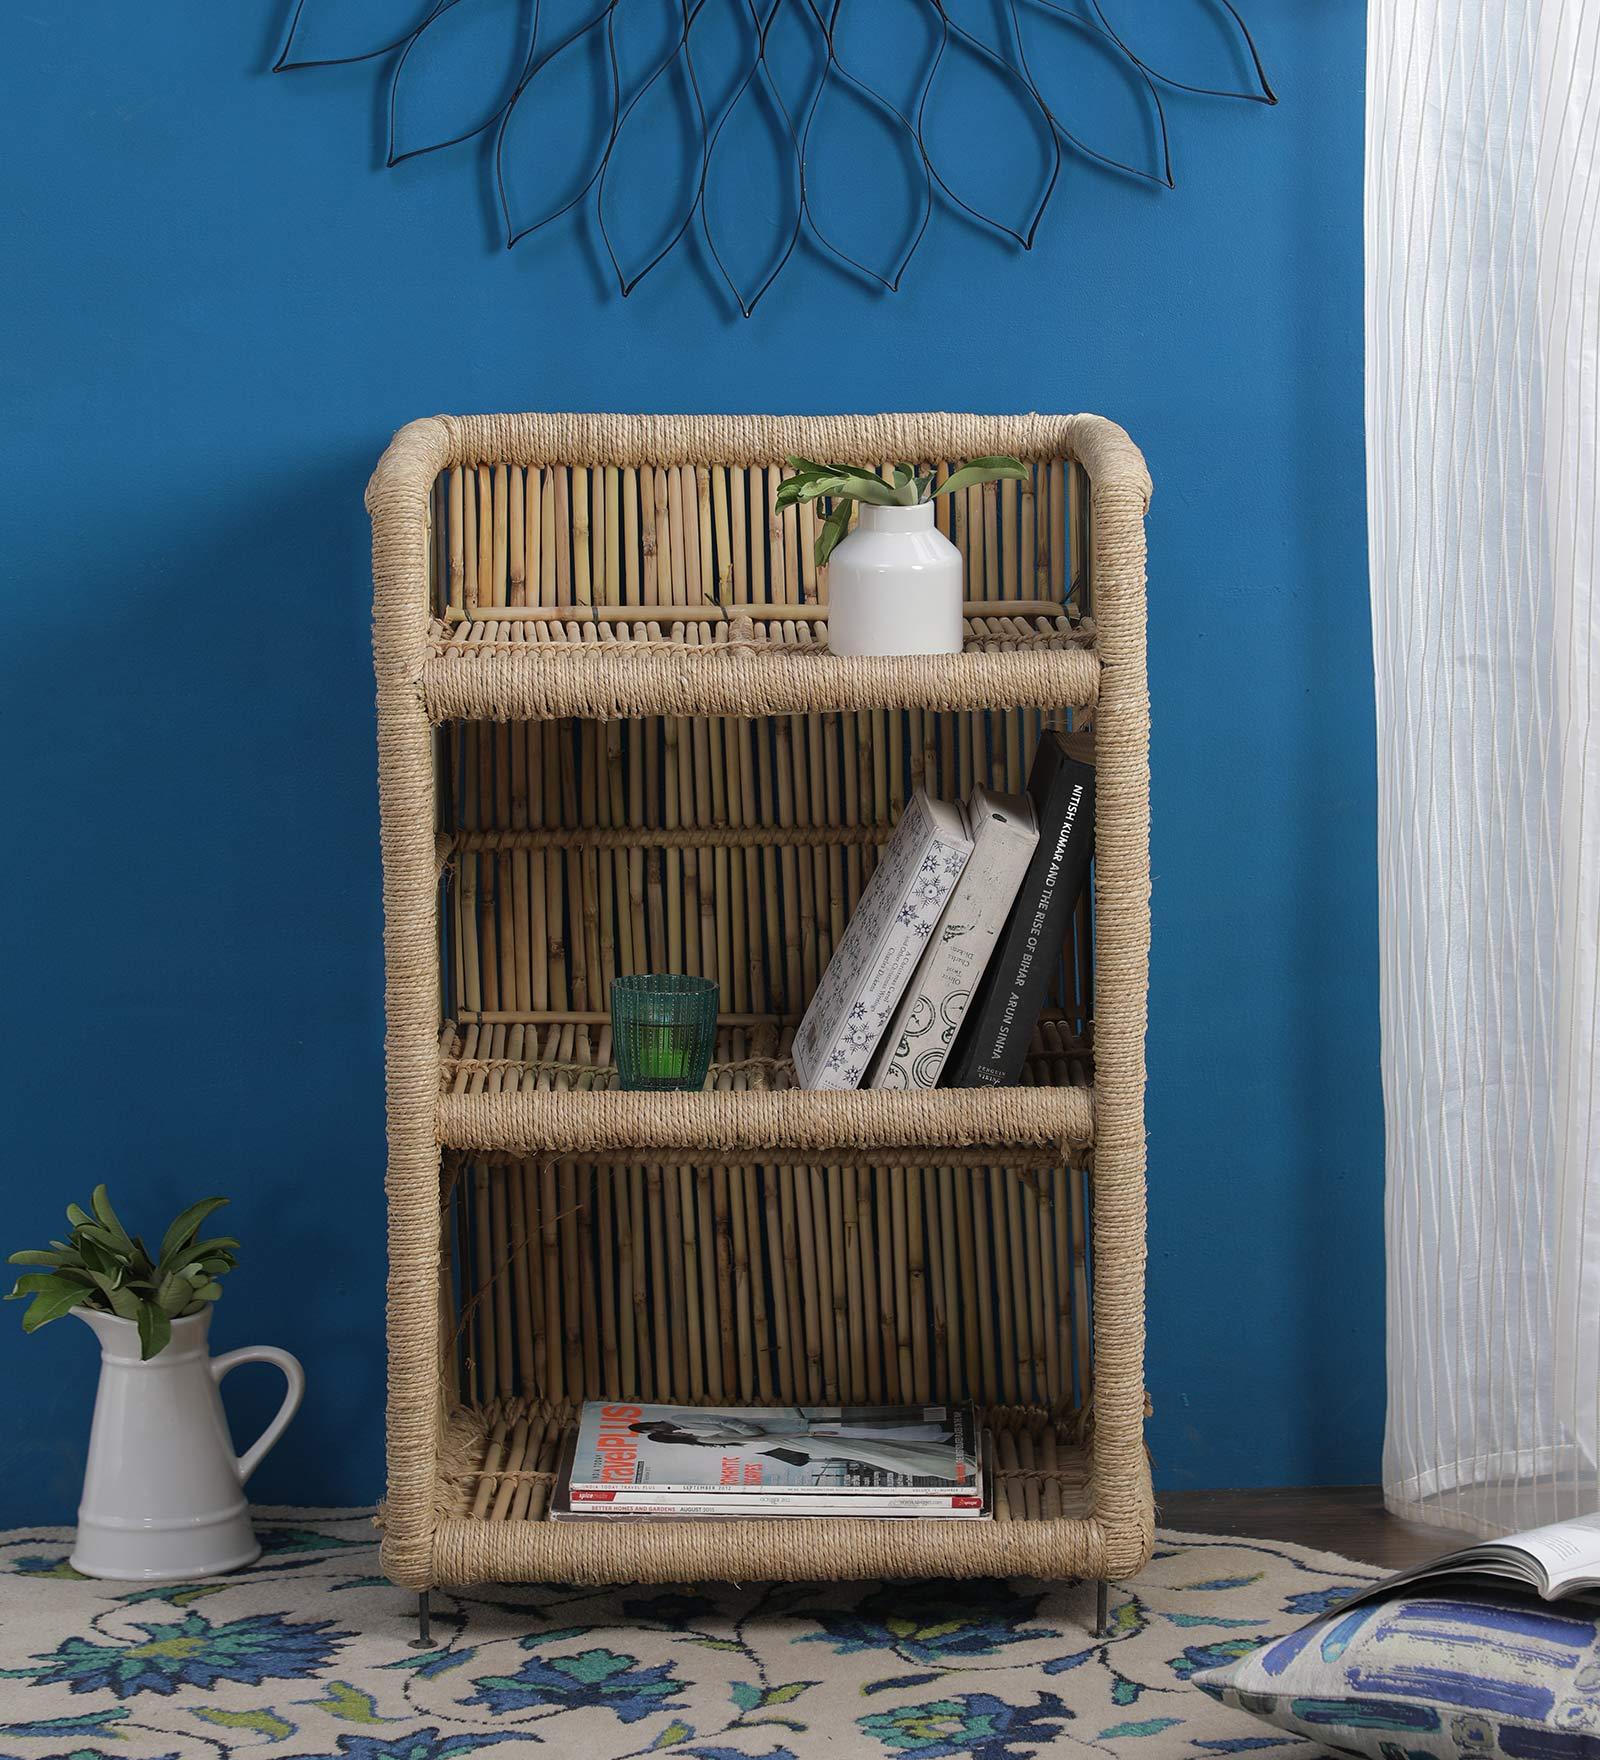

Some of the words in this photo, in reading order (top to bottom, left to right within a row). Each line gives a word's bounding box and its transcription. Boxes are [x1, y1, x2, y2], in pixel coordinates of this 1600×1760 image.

[1065, 784, 1084, 821] NITISH
[1052, 821, 1073, 862] KUMAR
[1045, 862, 1060, 887] AND
[1038, 889, 1053, 911] THE
[1030, 911, 1046, 936] RISE
[1025, 937, 1038, 953] OF
[881, 947, 896, 969] Charles
[1014, 953, 1033, 987] BIHAR
[869, 969, 885, 992] Dickens
[1002, 991, 1020, 1025] ARUN
[991, 1025, 1010, 1060] SINHA
